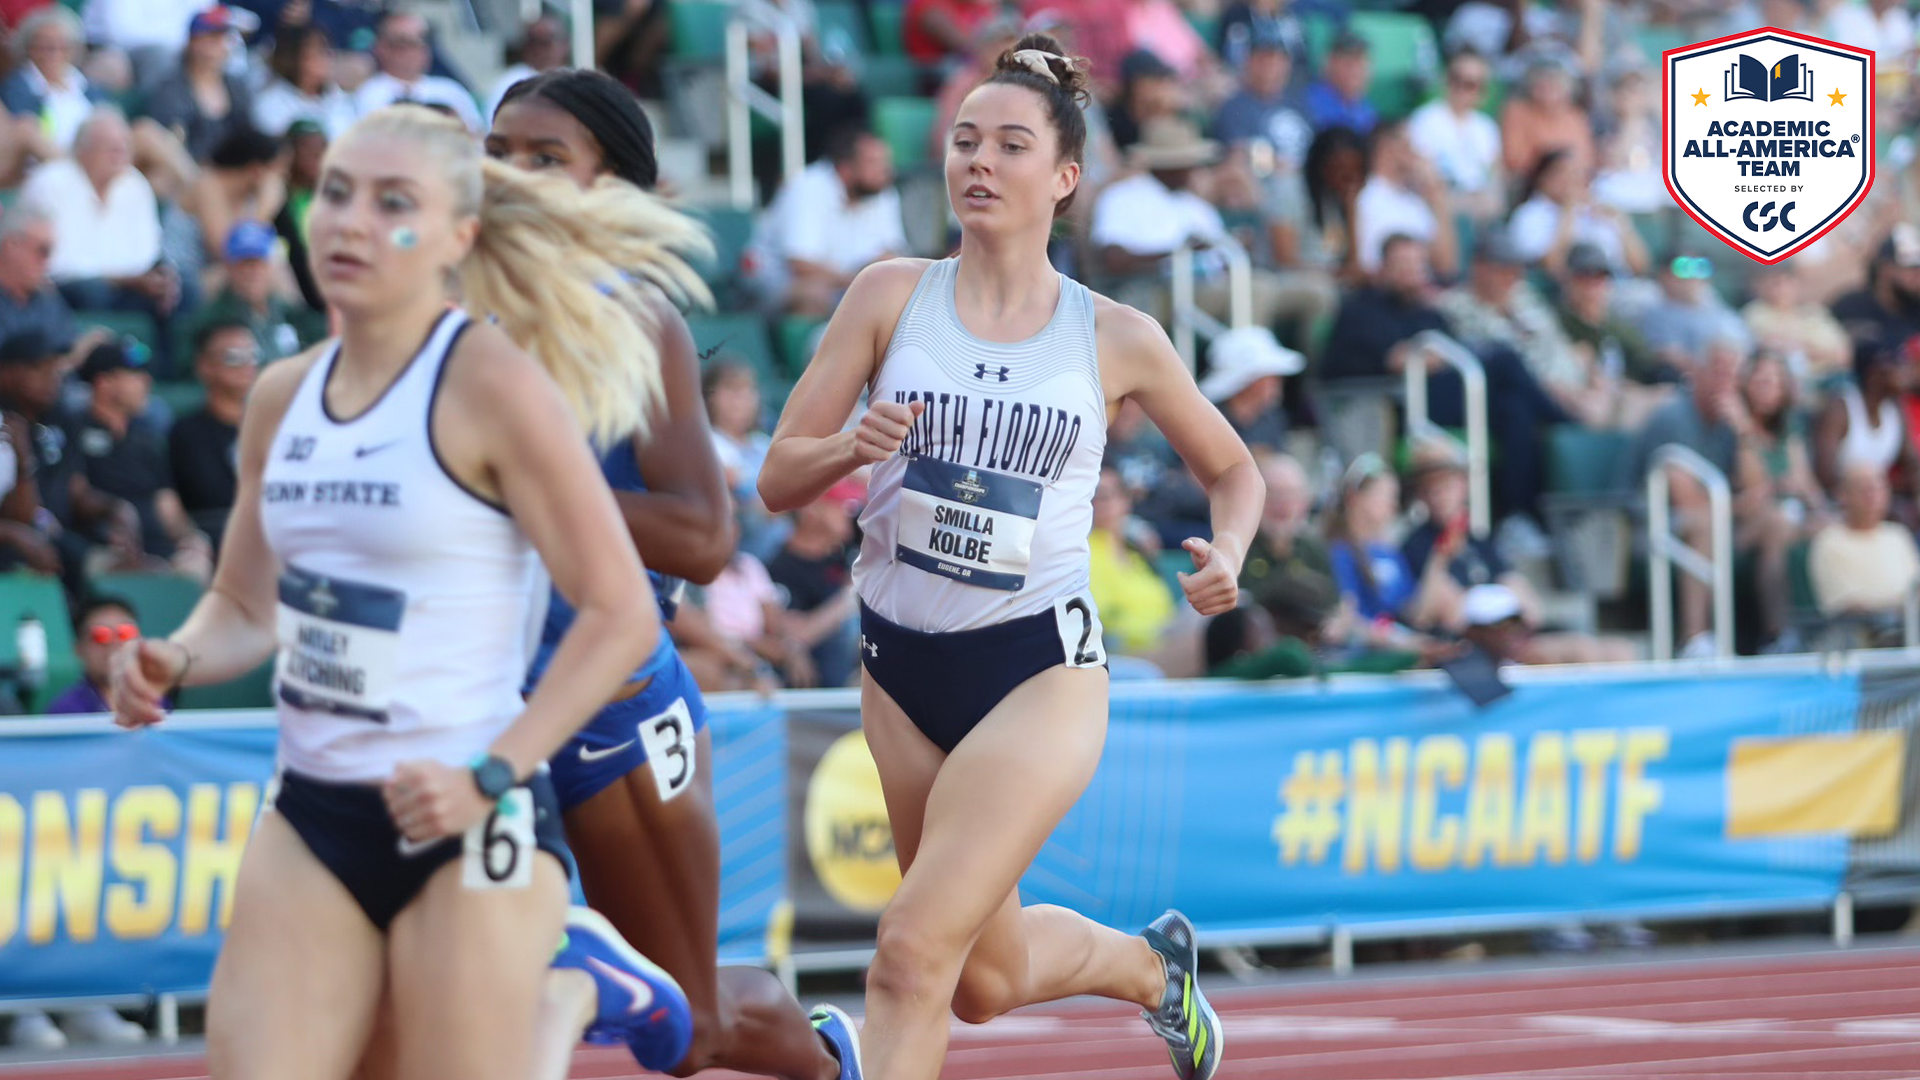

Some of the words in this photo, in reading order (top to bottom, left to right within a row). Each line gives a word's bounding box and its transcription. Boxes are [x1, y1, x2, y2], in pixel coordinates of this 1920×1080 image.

[974, 398, 1082, 481] FLORIDA
[313, 481, 401, 506] STATE
[934, 505, 994, 535] SMILLA
[928, 527, 992, 564] KOLBE
[961, 568, 972, 577] OR
[1065, 596, 1099, 666] 2
[654, 715, 688, 790] 3
[1271, 727, 1673, 876] #NCAATF
[483, 808, 518, 882] 6
